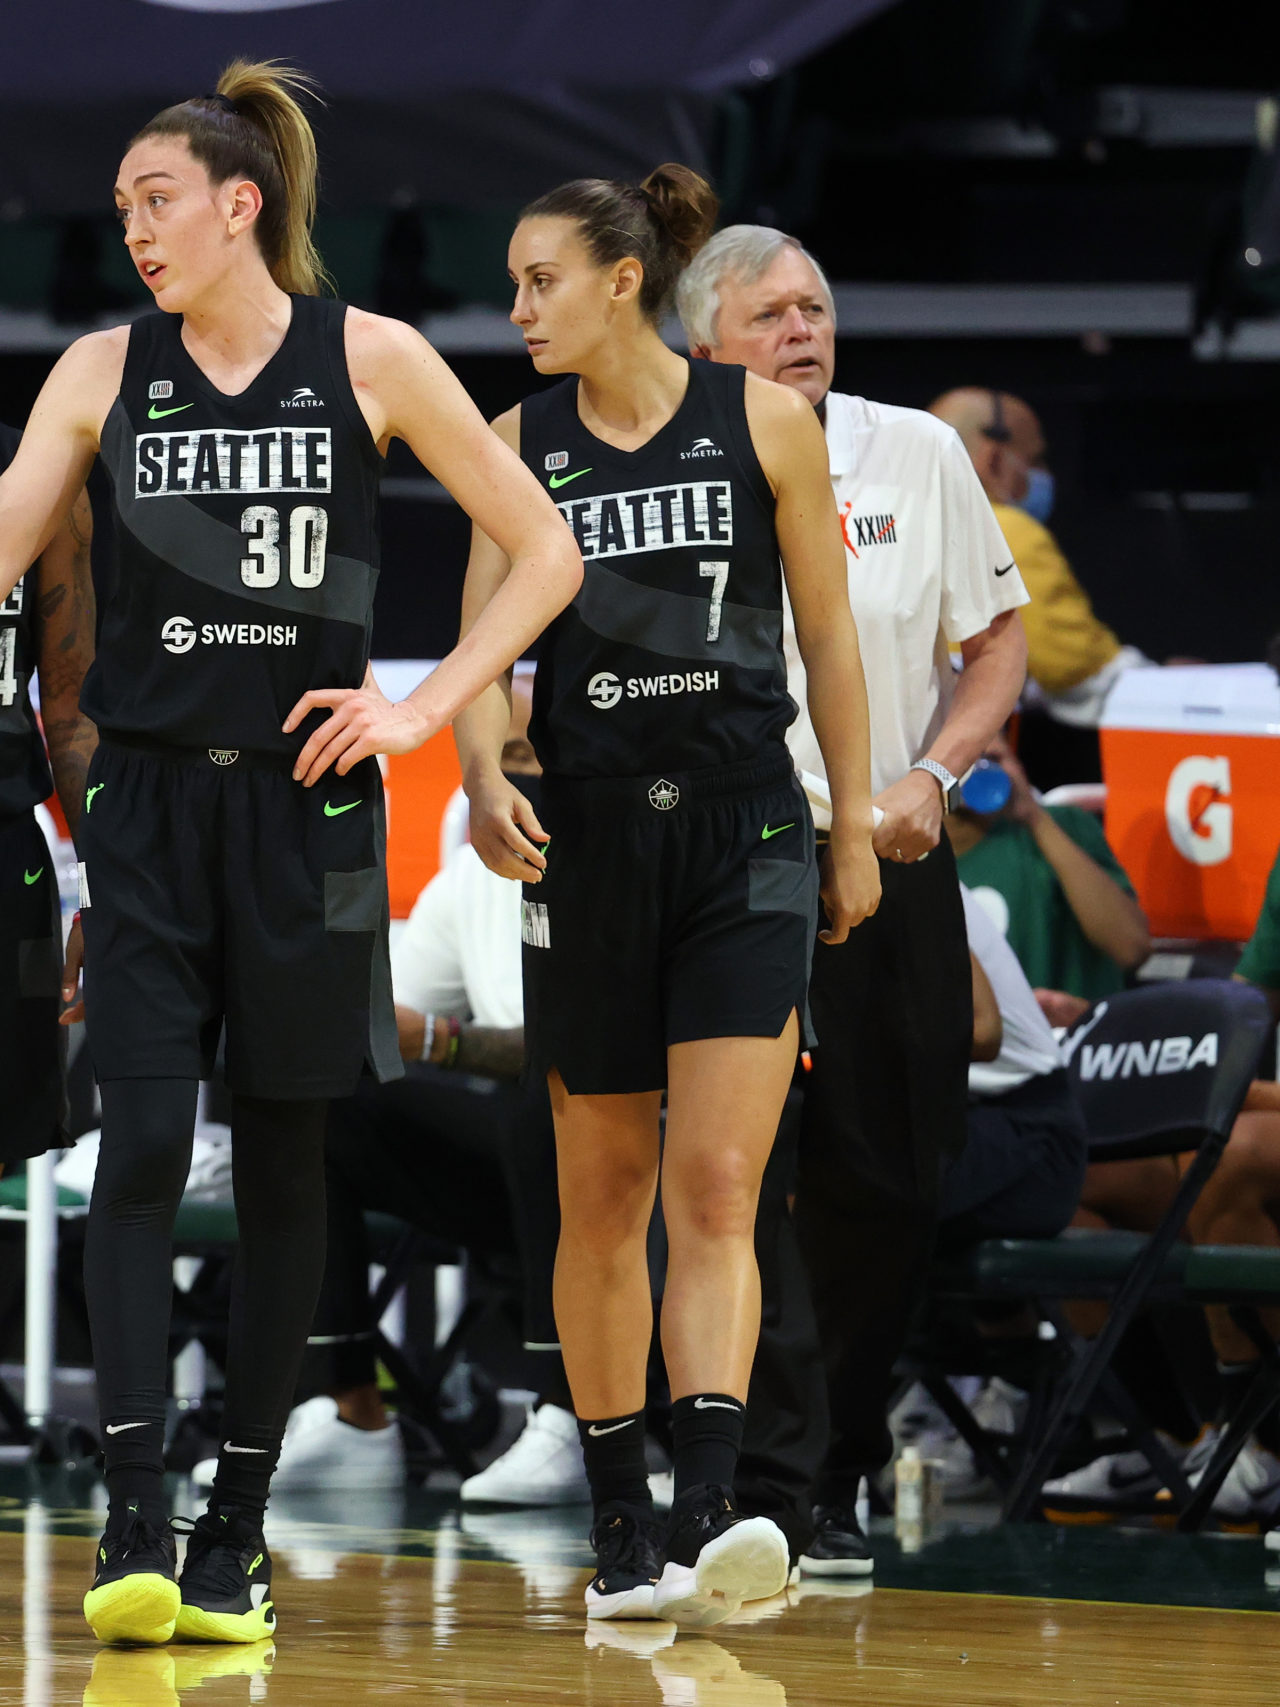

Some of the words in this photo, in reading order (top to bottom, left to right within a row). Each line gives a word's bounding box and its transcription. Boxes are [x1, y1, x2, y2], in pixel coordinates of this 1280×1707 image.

[280, 399, 325, 408] SYMETRA
[137, 431, 328, 494] SEATTLE
[680, 449, 724, 460] SYMETRA
[240, 505, 328, 588] 30
[558, 486, 729, 557] EATTLE
[699, 561, 730, 642] 7
[201, 624, 298, 646] SWEDISH
[626, 670, 719, 699] SWEDISH
[1166, 755, 1233, 866] G
[1080, 1032, 1218, 1082] WNBA
